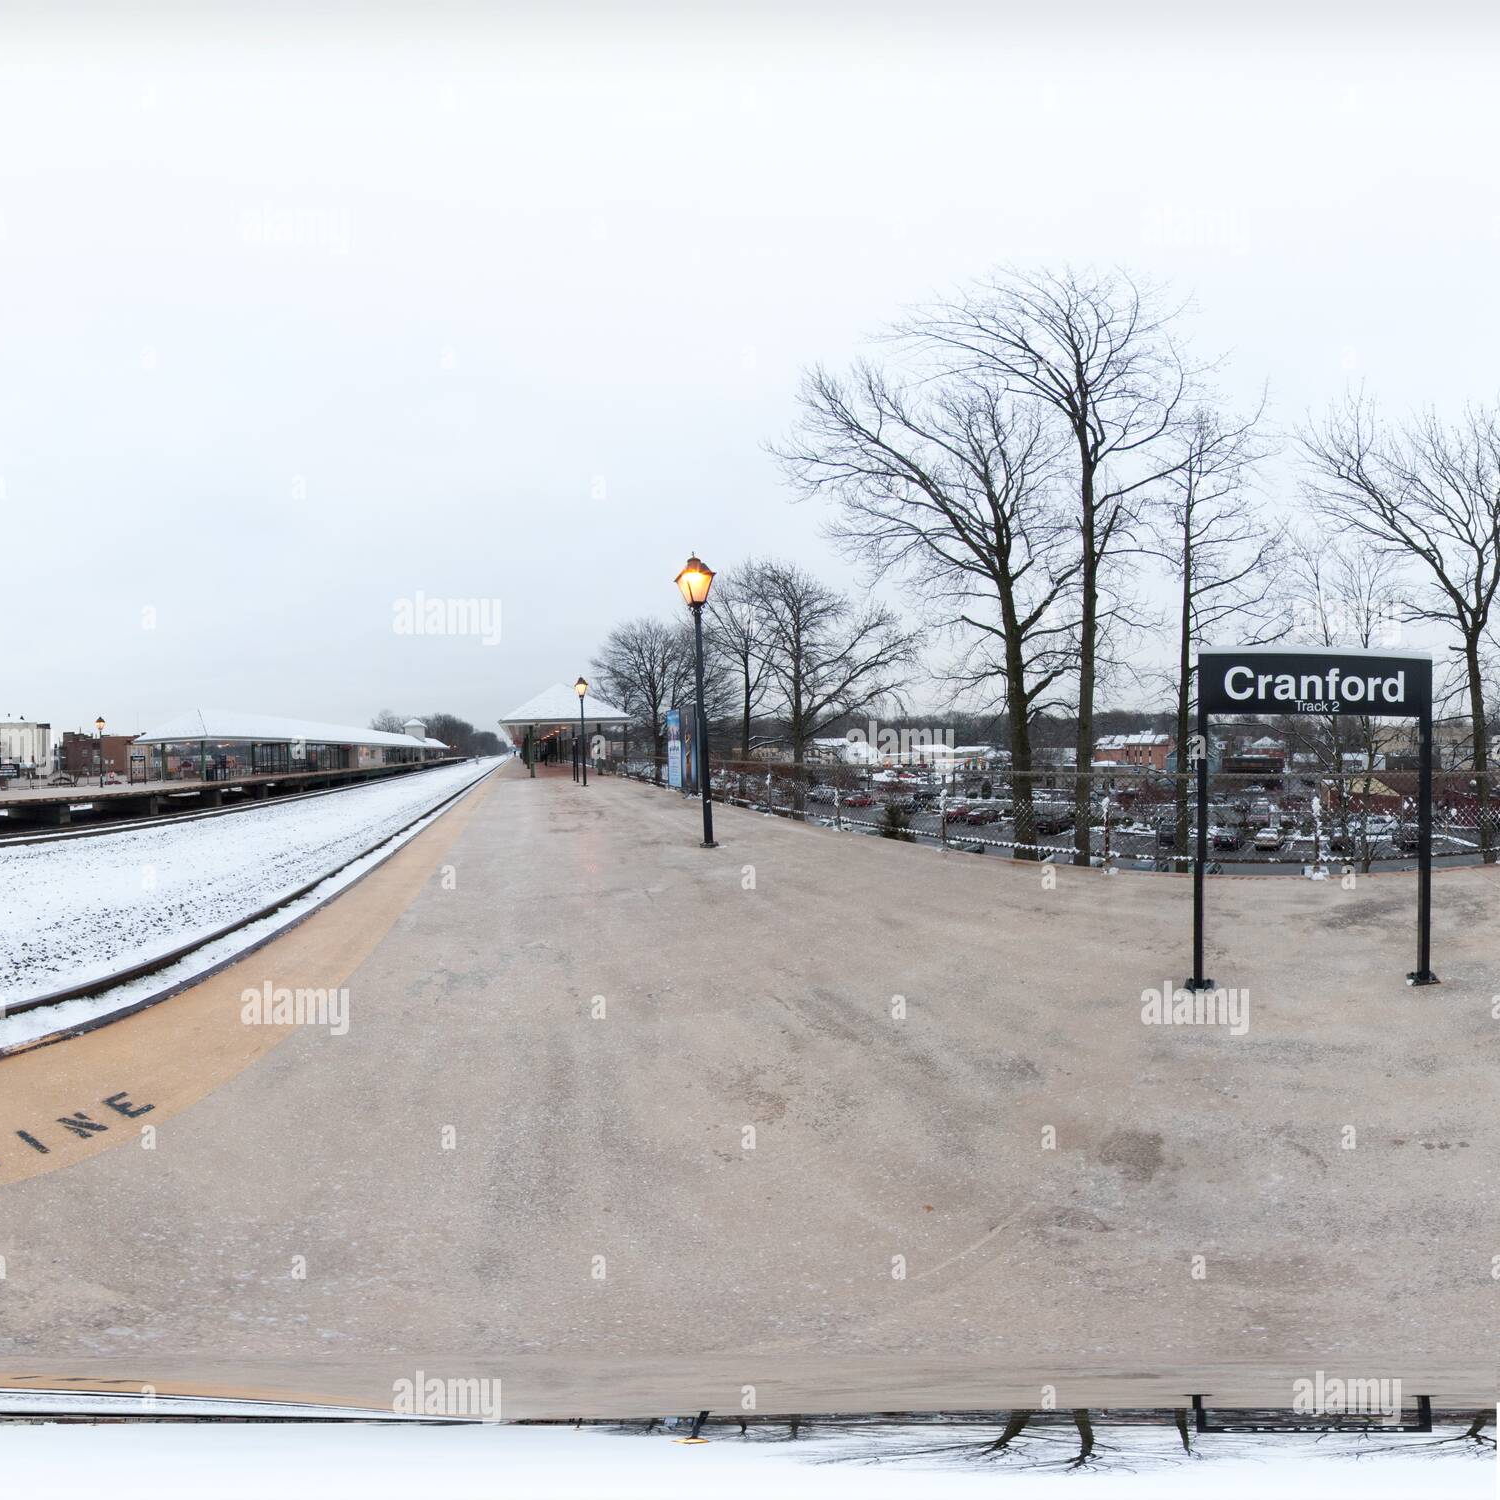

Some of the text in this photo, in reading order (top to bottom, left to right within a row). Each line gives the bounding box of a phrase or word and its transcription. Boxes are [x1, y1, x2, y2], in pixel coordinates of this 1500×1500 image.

[1224, 666, 1405, 703] Cranford
[1294, 700, 1340, 712] Track 2
